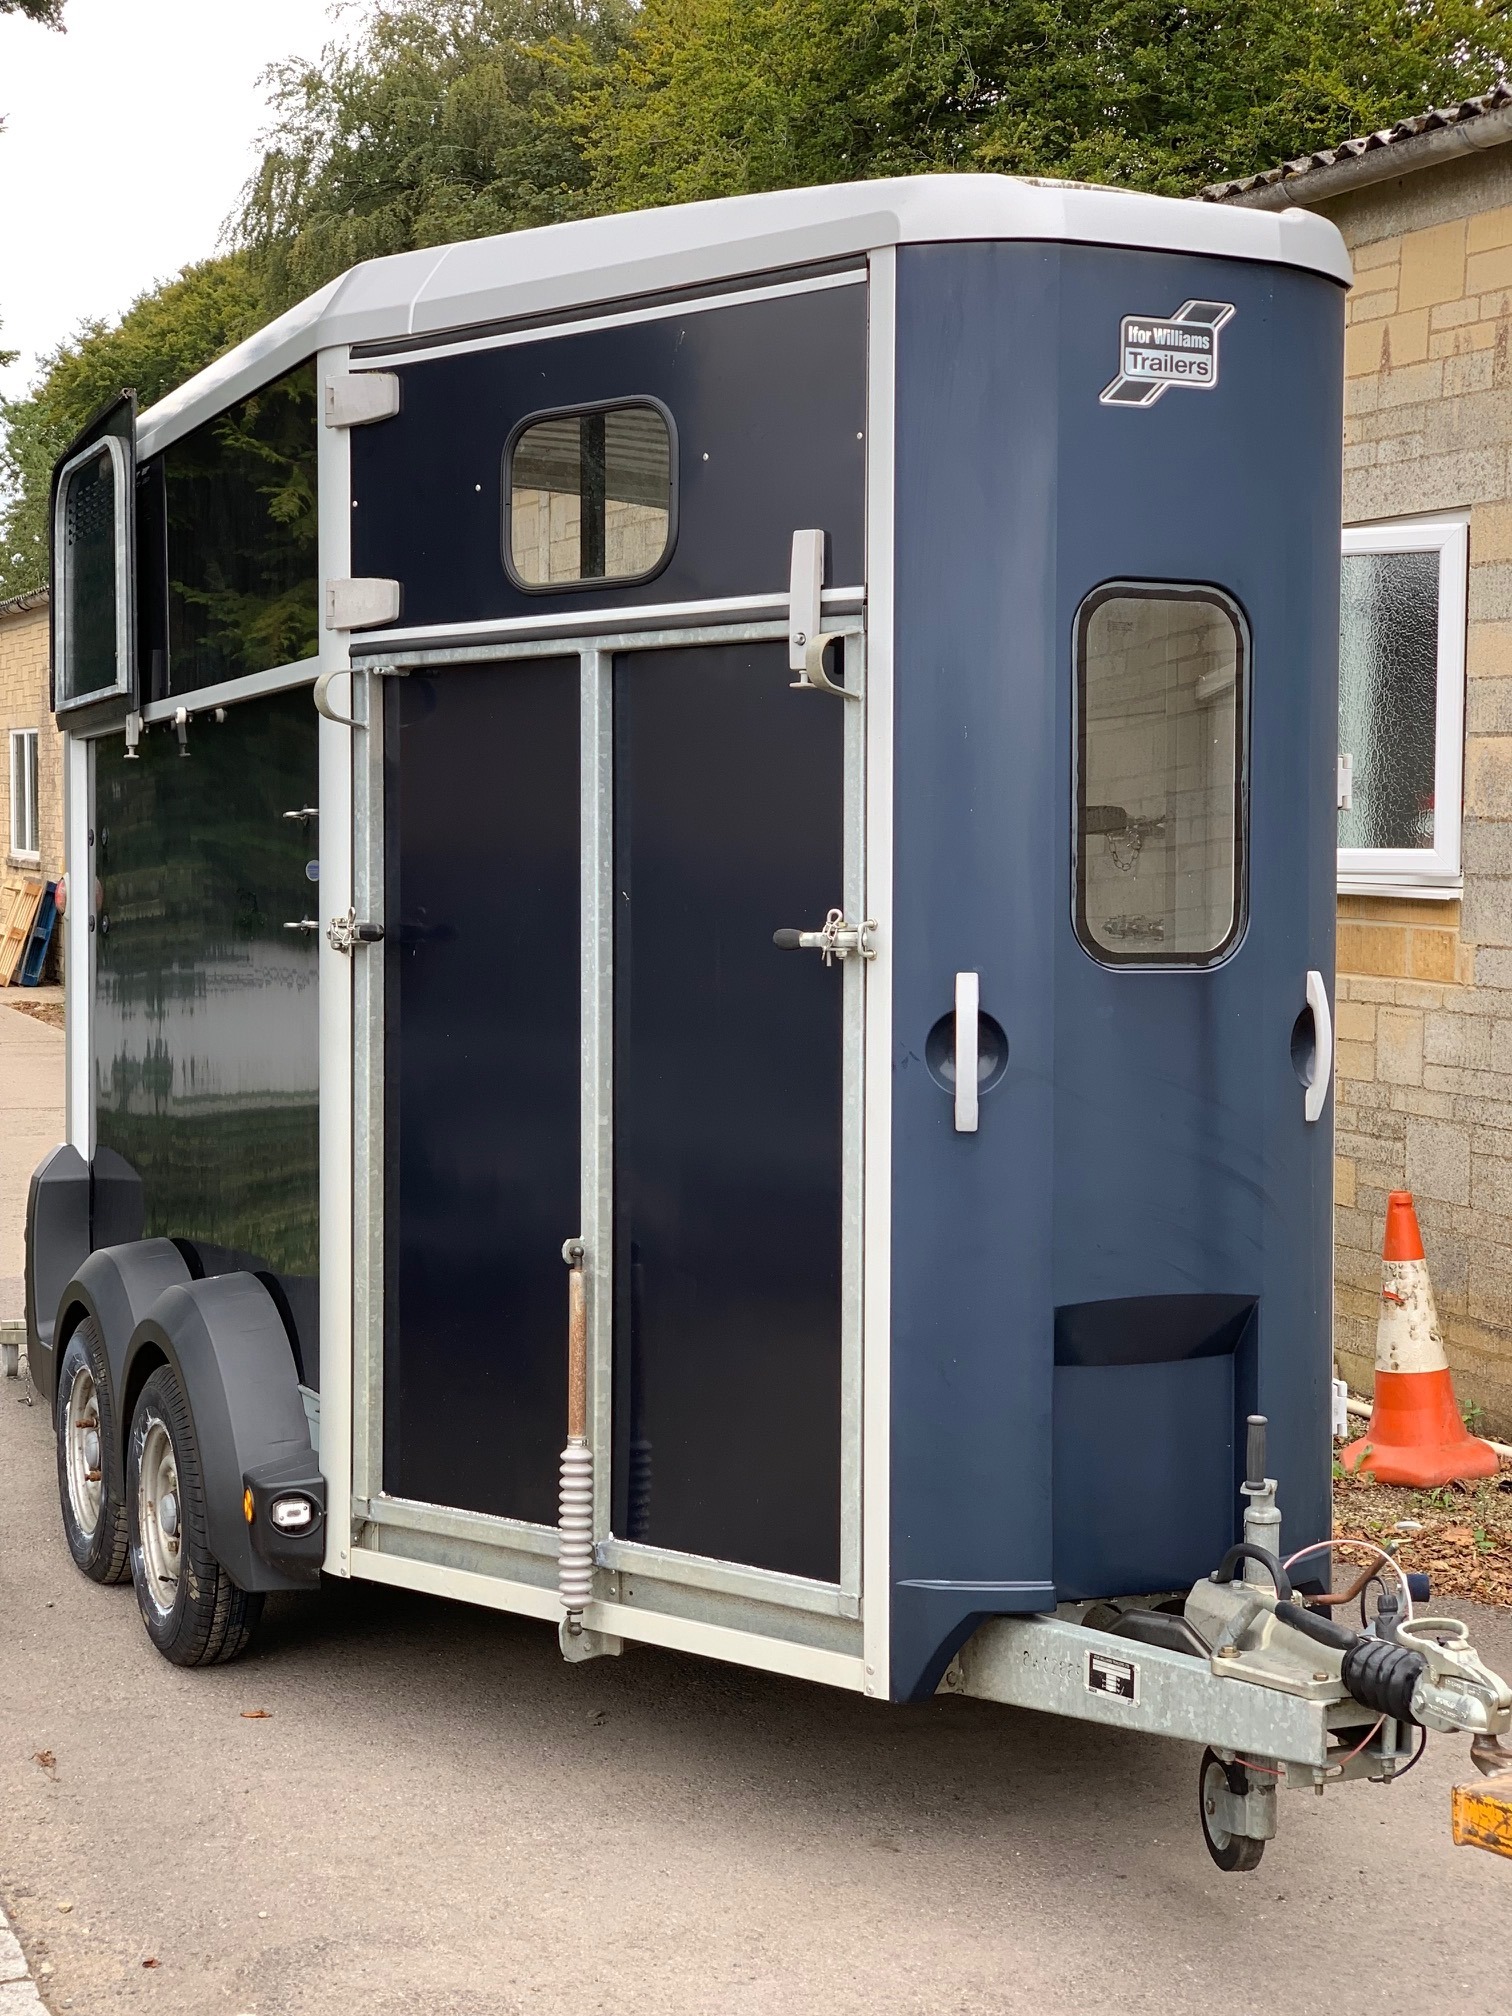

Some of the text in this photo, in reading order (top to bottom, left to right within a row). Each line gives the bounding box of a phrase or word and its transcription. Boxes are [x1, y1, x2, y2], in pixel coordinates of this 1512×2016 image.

[1128, 325, 1210, 349] Ifor Williams
[1128, 351, 1209, 376] Trailers
